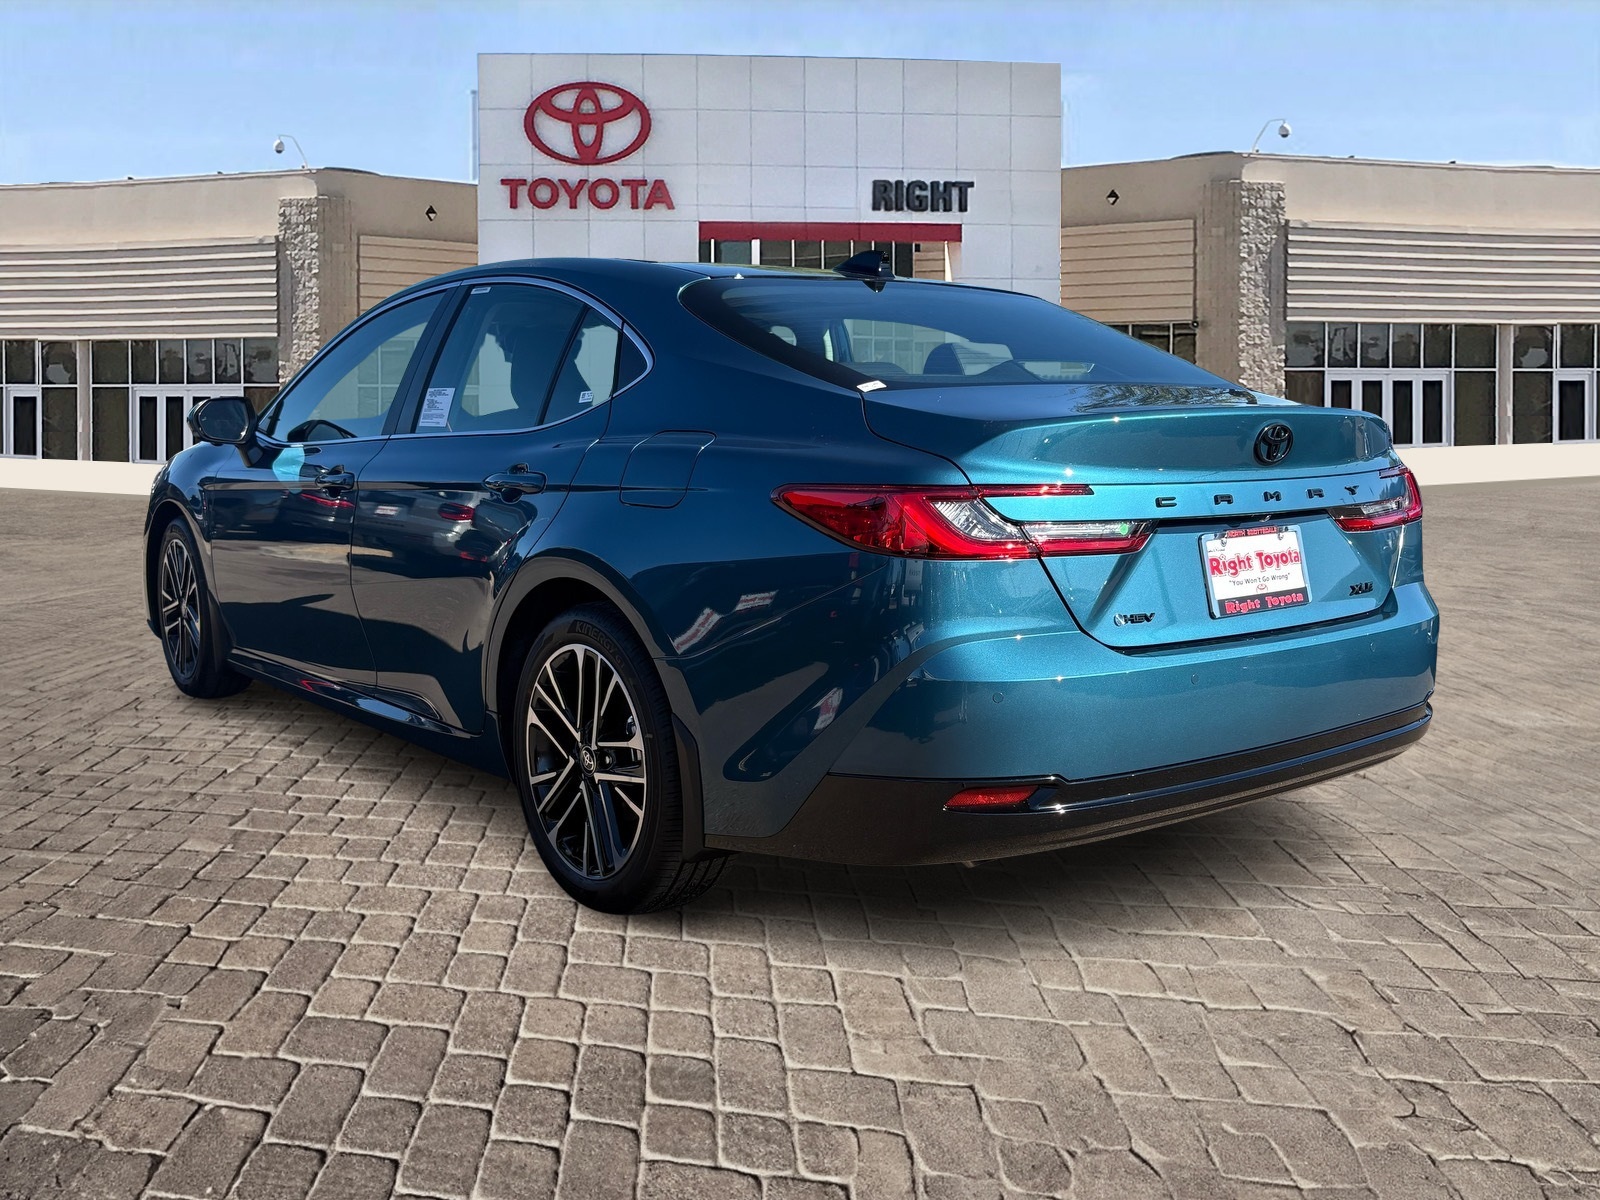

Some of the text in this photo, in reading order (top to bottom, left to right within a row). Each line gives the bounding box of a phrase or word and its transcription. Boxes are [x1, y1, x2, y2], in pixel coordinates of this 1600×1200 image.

[500, 178, 675, 210] TOYOTA
[871, 179, 975, 213] RIGHT
[1155, 484, 1360, 508] CAMRY
[1208, 547, 1301, 577] Right Toyota
[1225, 593, 1304, 614] Right Toyota
[1349, 581, 1374, 596] XLE
[575, 620, 617, 652] KINERGY
